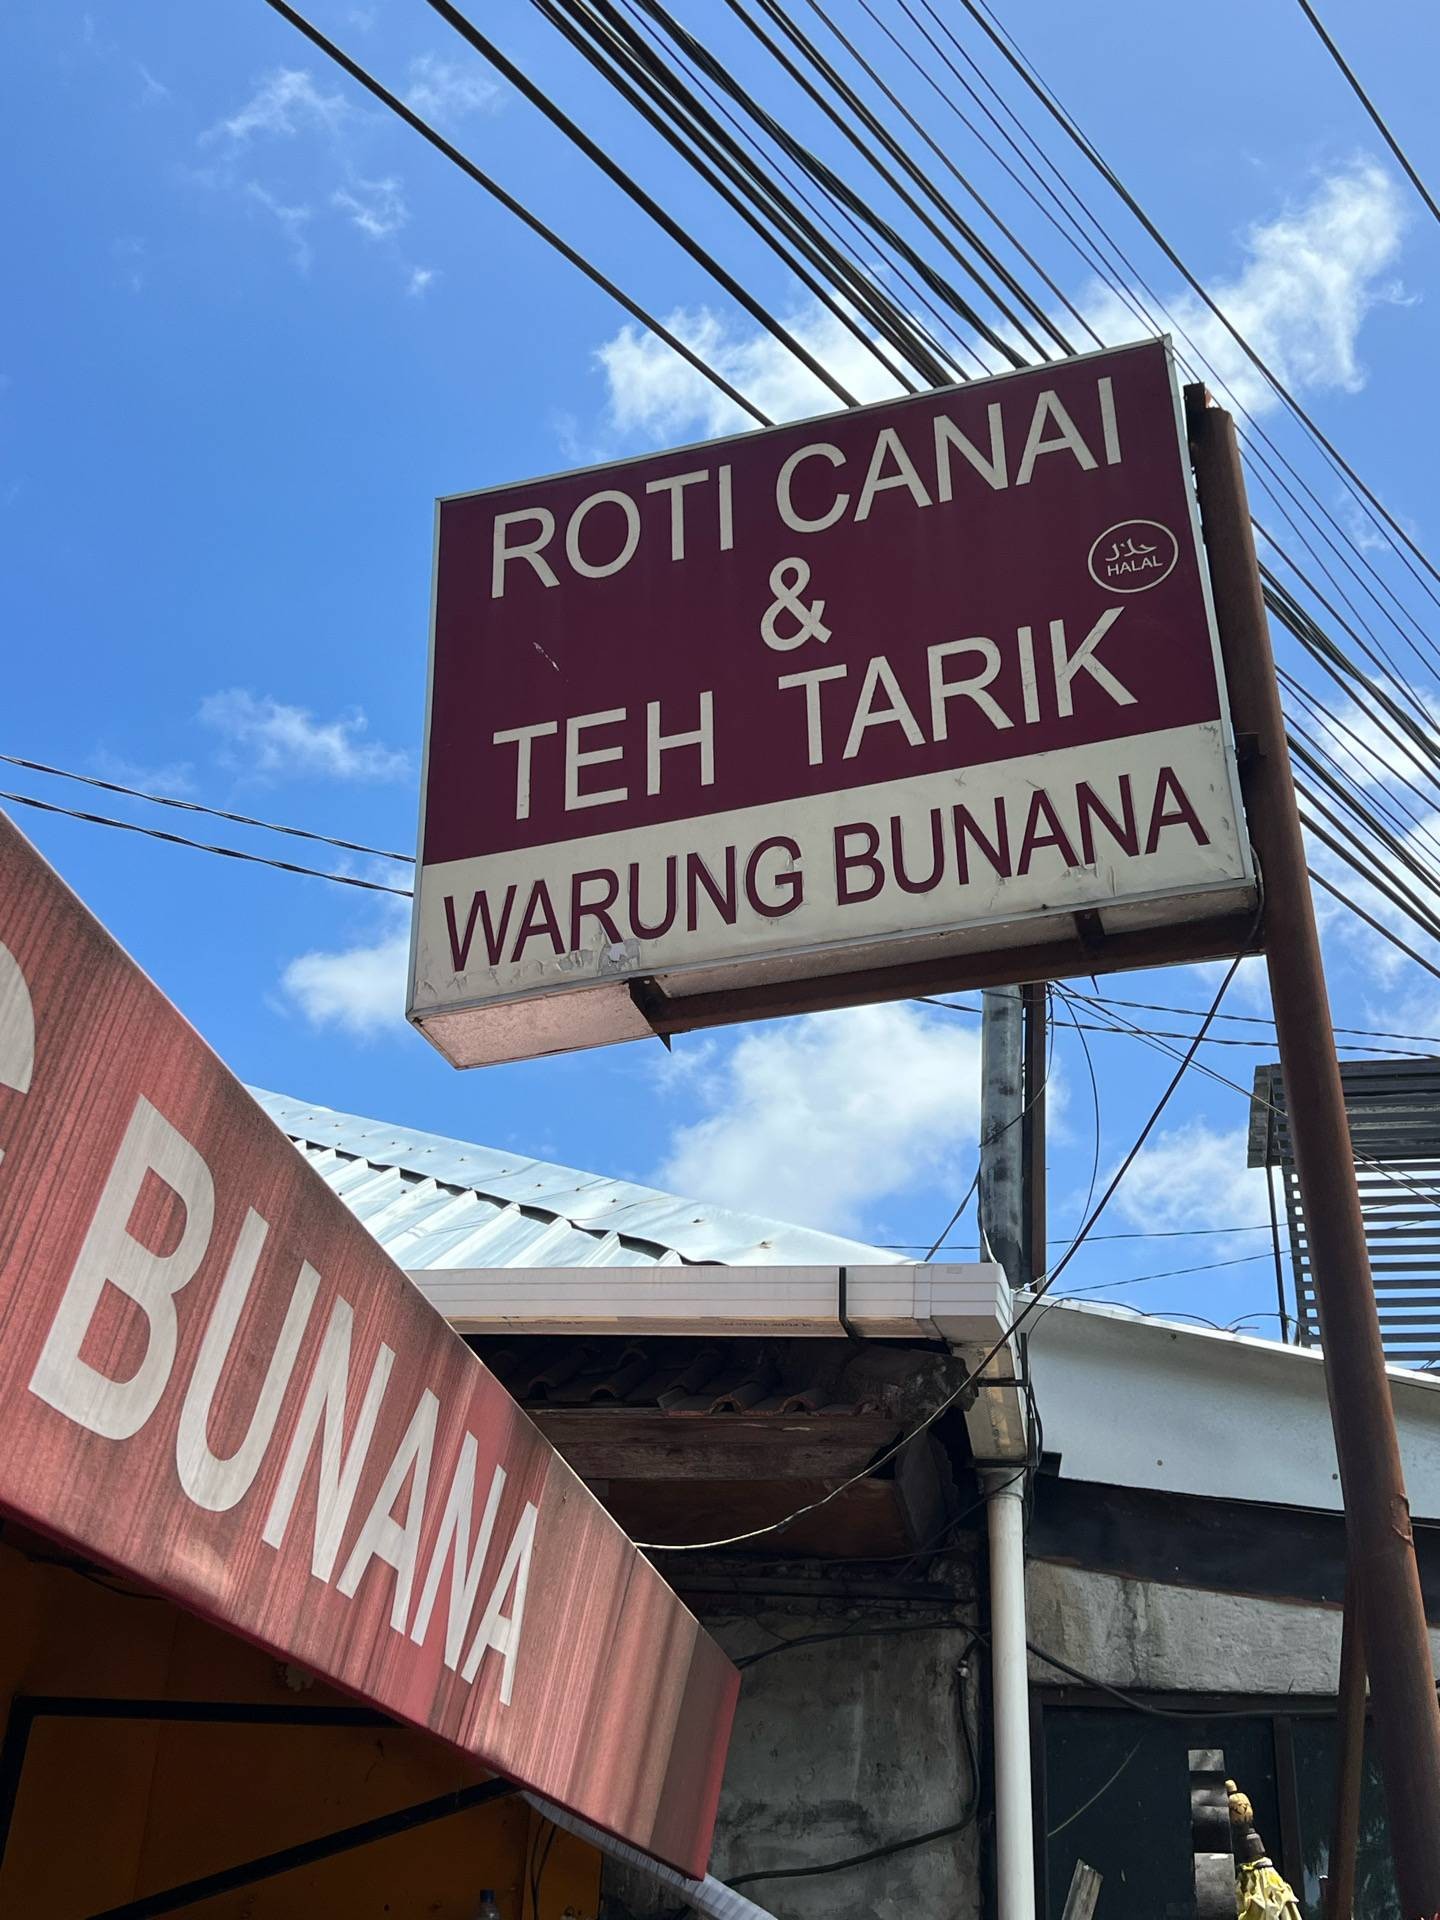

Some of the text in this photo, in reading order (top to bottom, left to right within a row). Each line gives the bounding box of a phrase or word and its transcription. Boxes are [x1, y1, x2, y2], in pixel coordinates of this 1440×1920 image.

[492, 376, 1122, 599] ROTI CANAI
[1107, 555, 1163, 577] HALAL
[760, 557, 832, 651] &
[493, 606, 1138, 820] TEH TARIK
[443, 766, 1211, 972] WARUNG BUNANA
[28, 1093, 538, 1707] BUNANA
